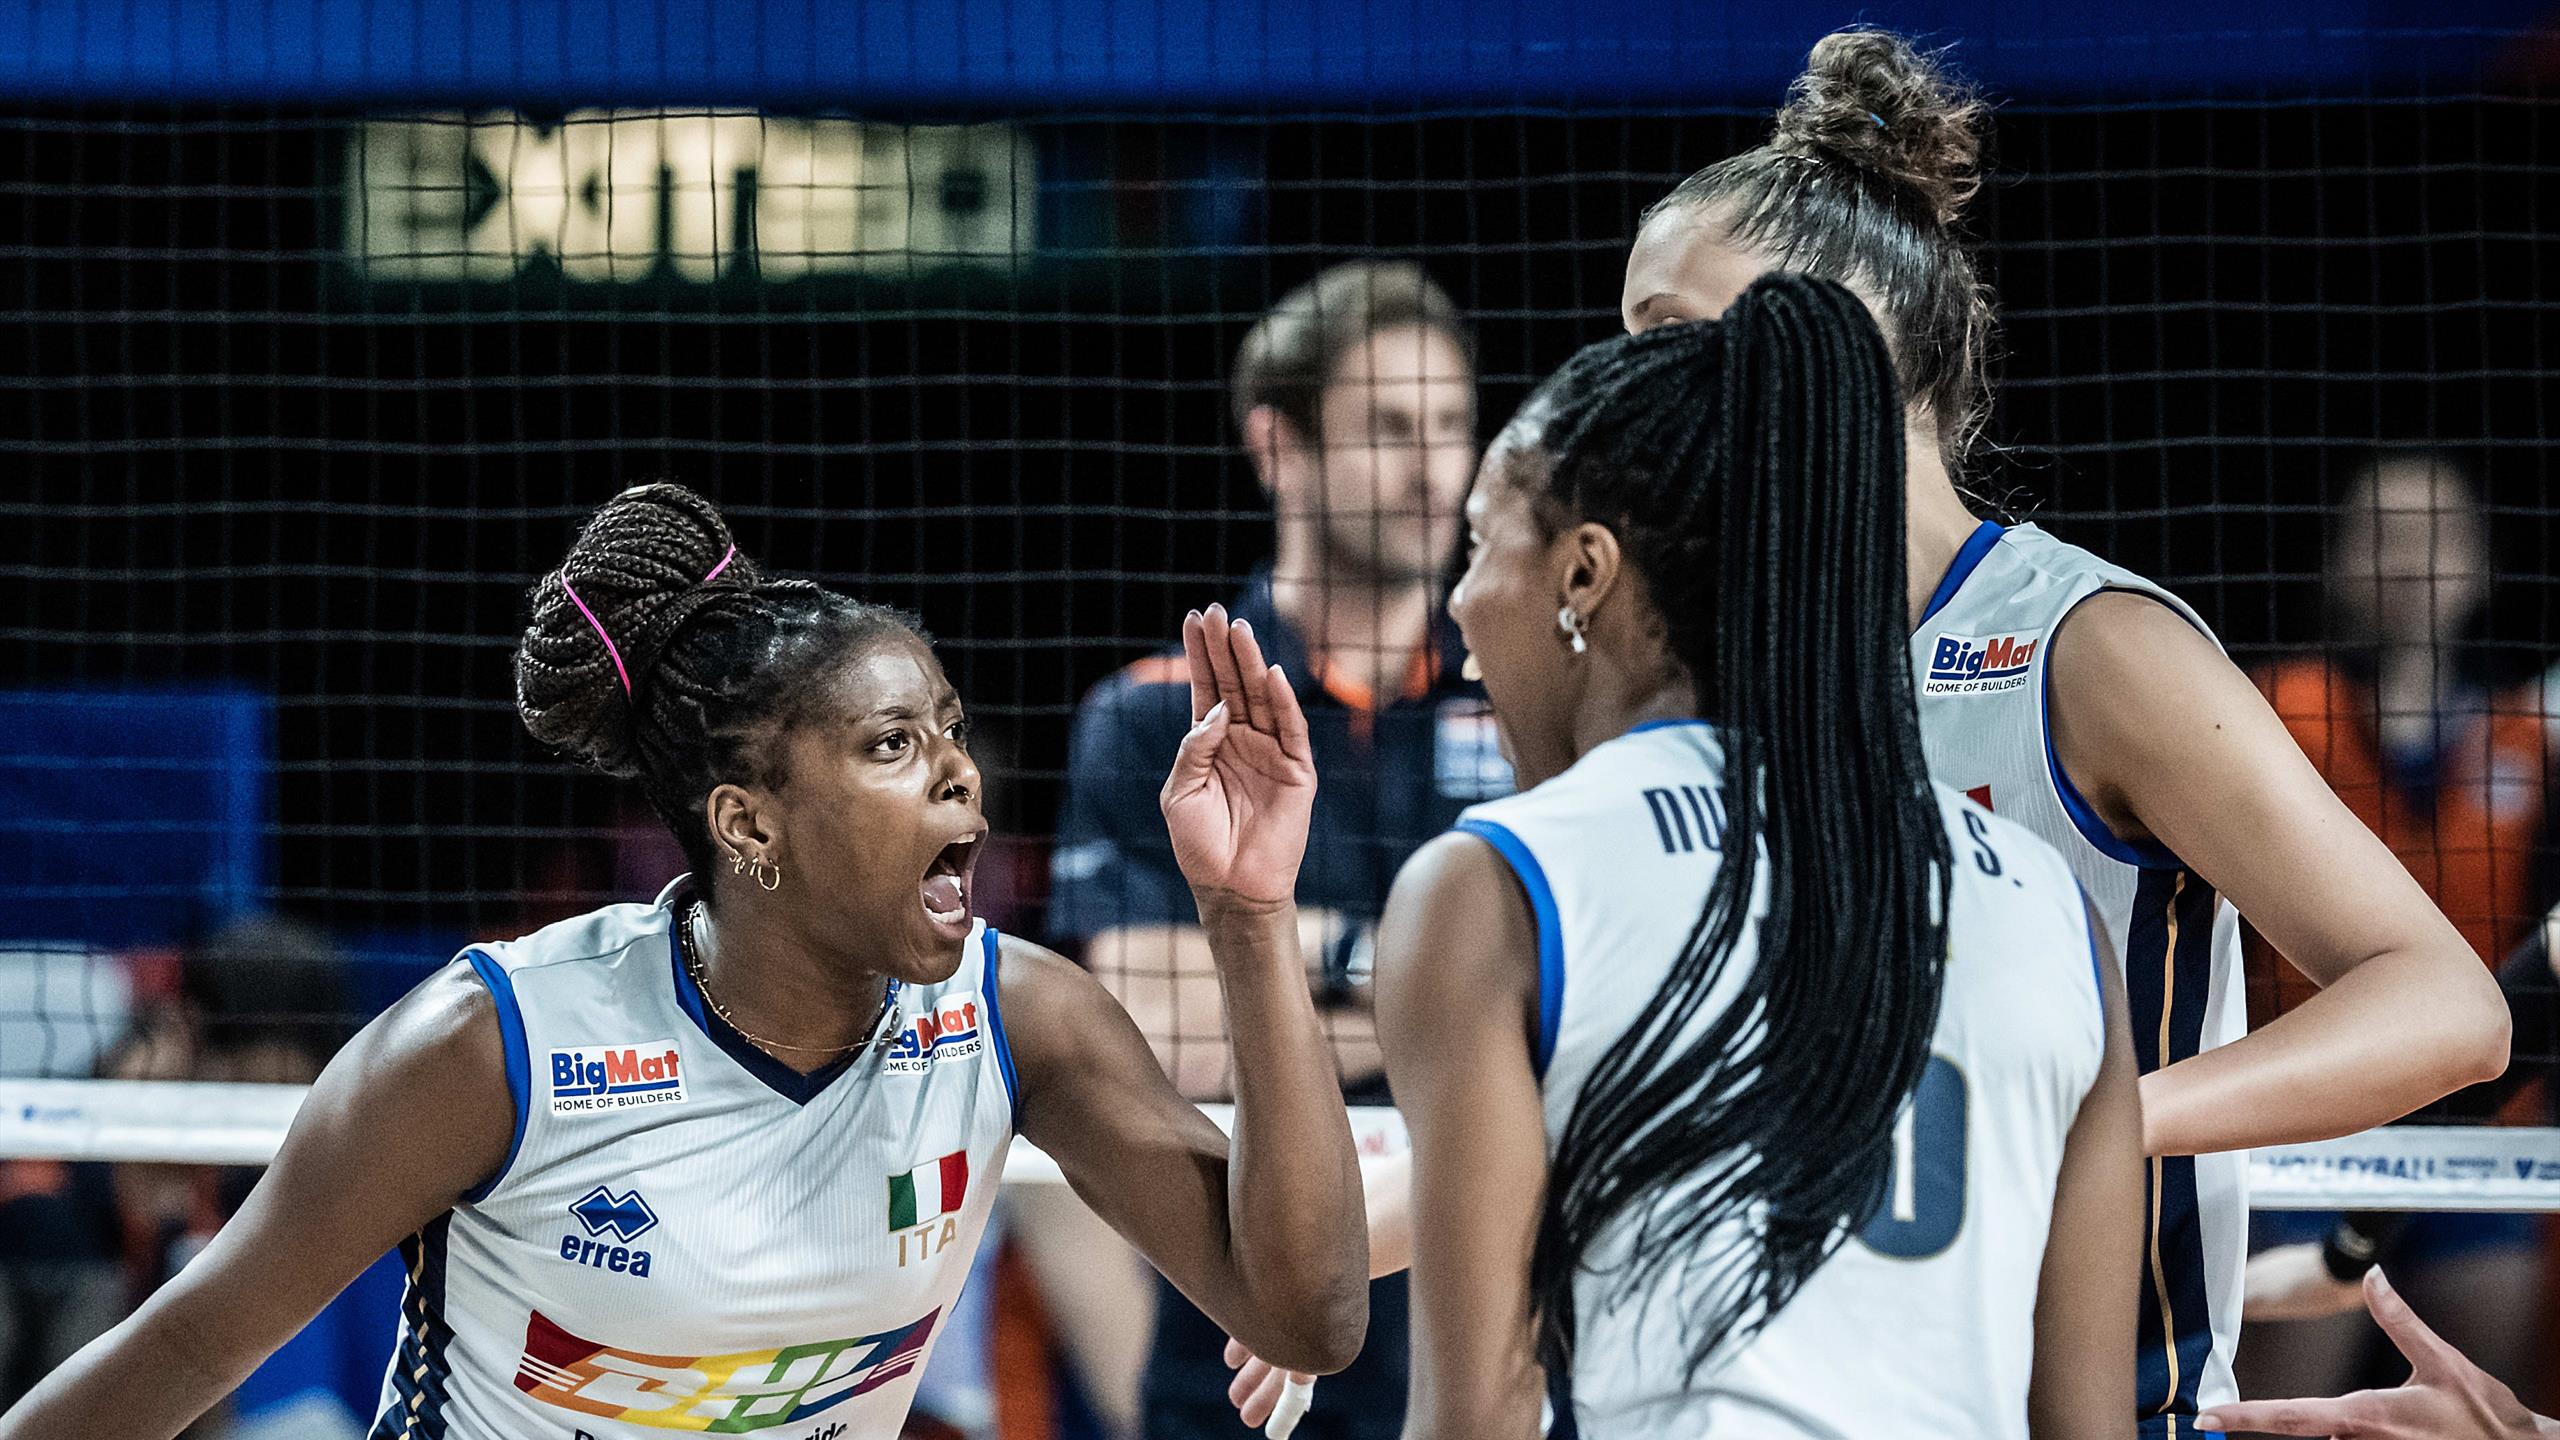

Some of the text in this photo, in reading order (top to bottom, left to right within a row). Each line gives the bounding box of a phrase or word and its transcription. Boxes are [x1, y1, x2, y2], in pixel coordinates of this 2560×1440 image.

[1931, 636, 2038, 681] BigMat
[1925, 675, 2027, 693] HOME OF BUILDERS
[894, 1002, 977, 1058] gMat
[551, 1050, 679, 1095] BigMat
[912, 1061, 928, 1071] OF
[931, 1040, 982, 1064] UILDERS
[554, 1091, 682, 1111] HOME OF BUILDERS
[898, 1217, 956, 1268] ITA
